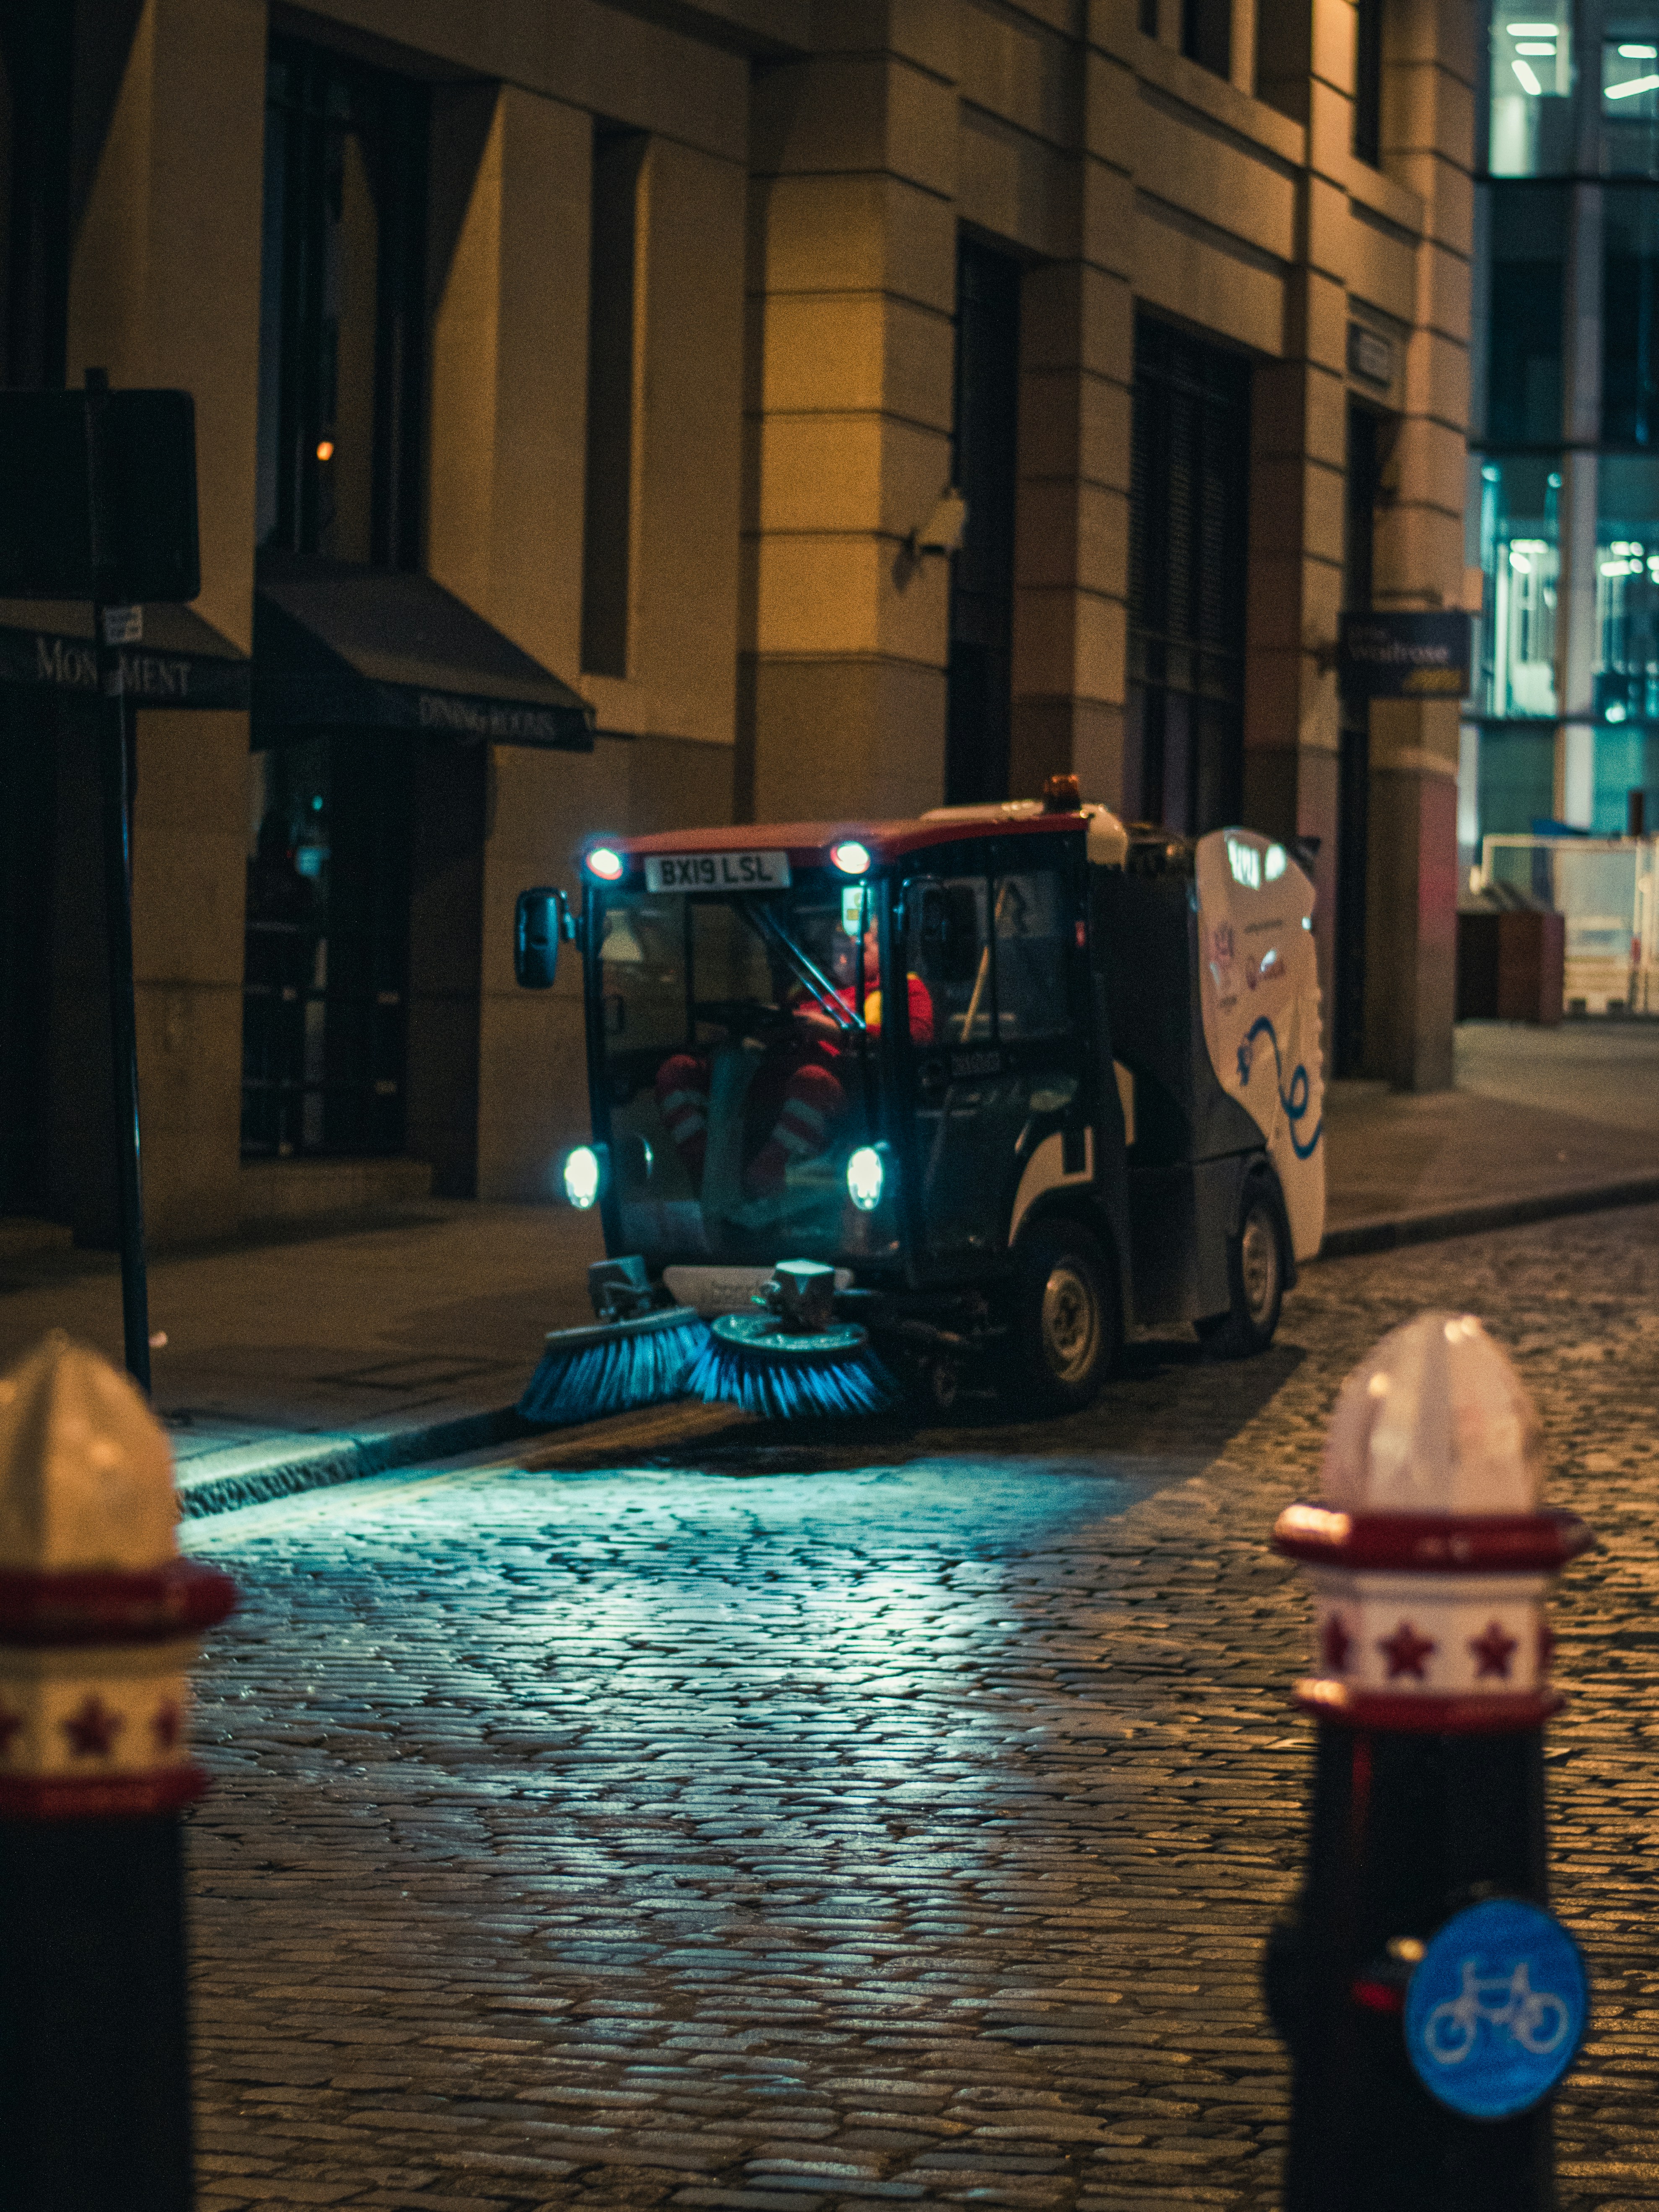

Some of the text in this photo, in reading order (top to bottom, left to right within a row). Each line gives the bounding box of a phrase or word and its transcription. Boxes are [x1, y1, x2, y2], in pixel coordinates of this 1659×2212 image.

[35, 636, 191, 697] MONMENT
[660, 856, 772, 886] BX19 LSL
